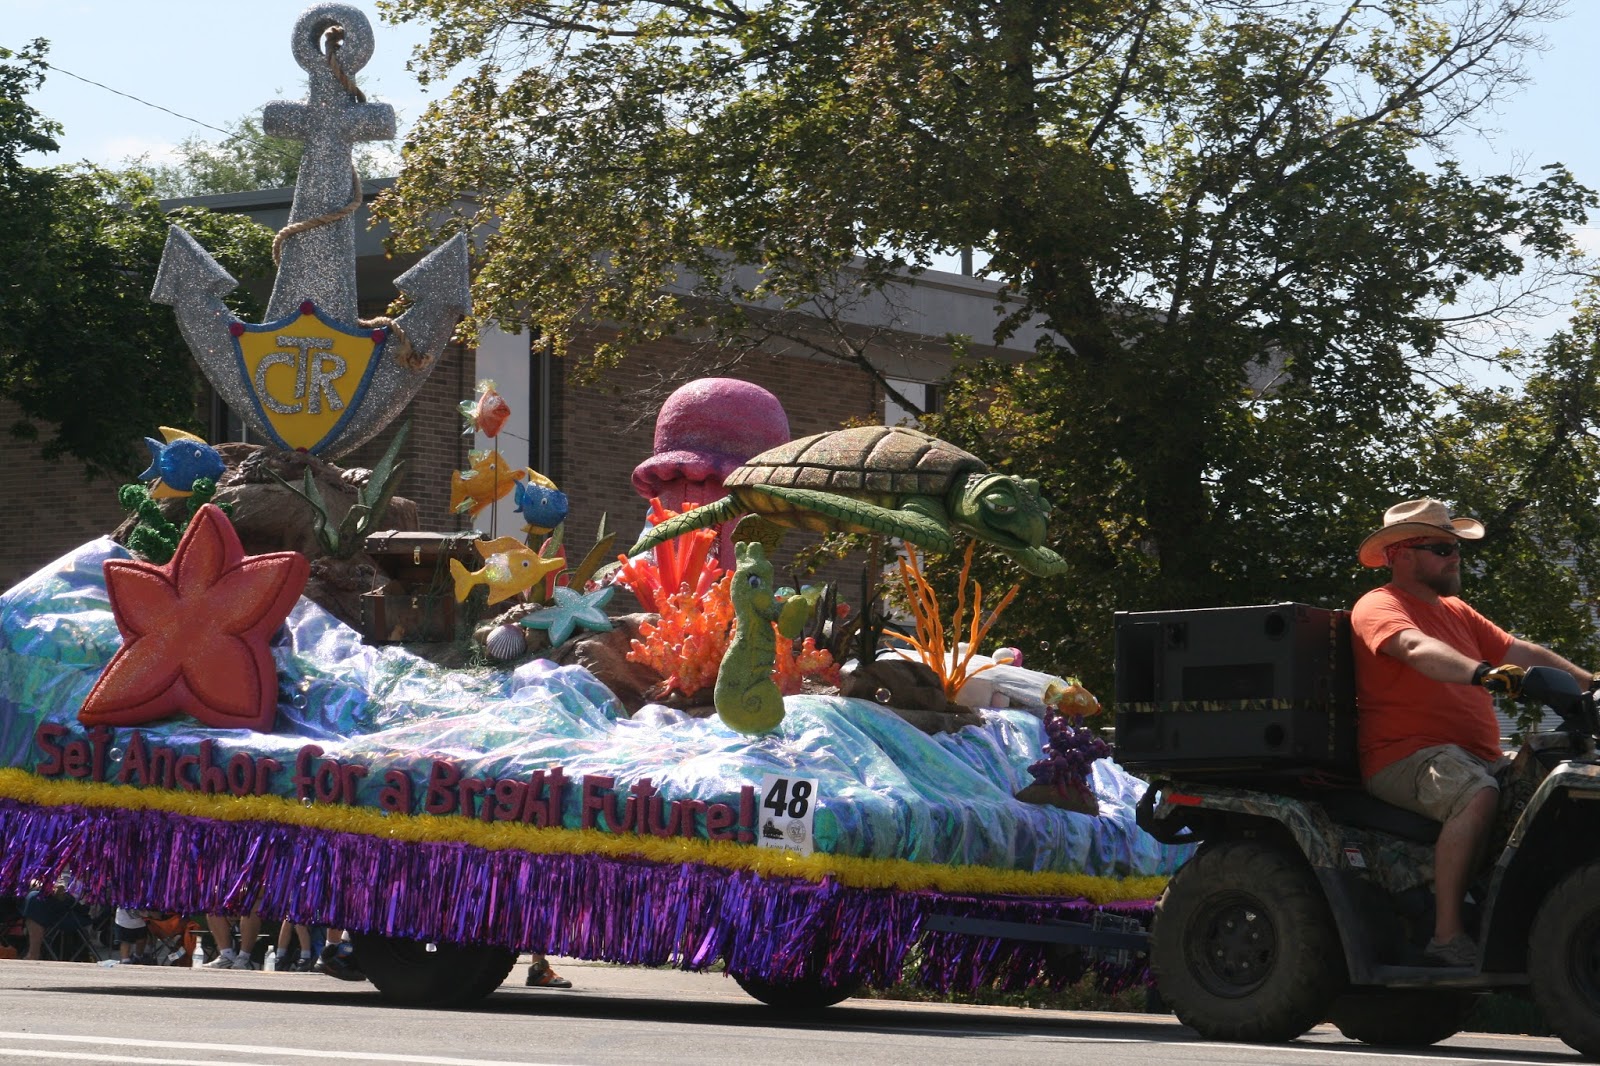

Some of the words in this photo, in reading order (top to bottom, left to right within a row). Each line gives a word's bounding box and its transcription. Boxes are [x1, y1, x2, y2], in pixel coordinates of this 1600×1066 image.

[255, 335, 347, 414] CTR
[36, 723, 112, 782] Set
[117, 730, 283, 797] Anchor
[291, 744, 369, 805] for
[378, 769, 414, 815] a
[424, 760, 571, 829] Bright
[581, 774, 756, 842] Future!
[763, 778, 812, 818] 48
